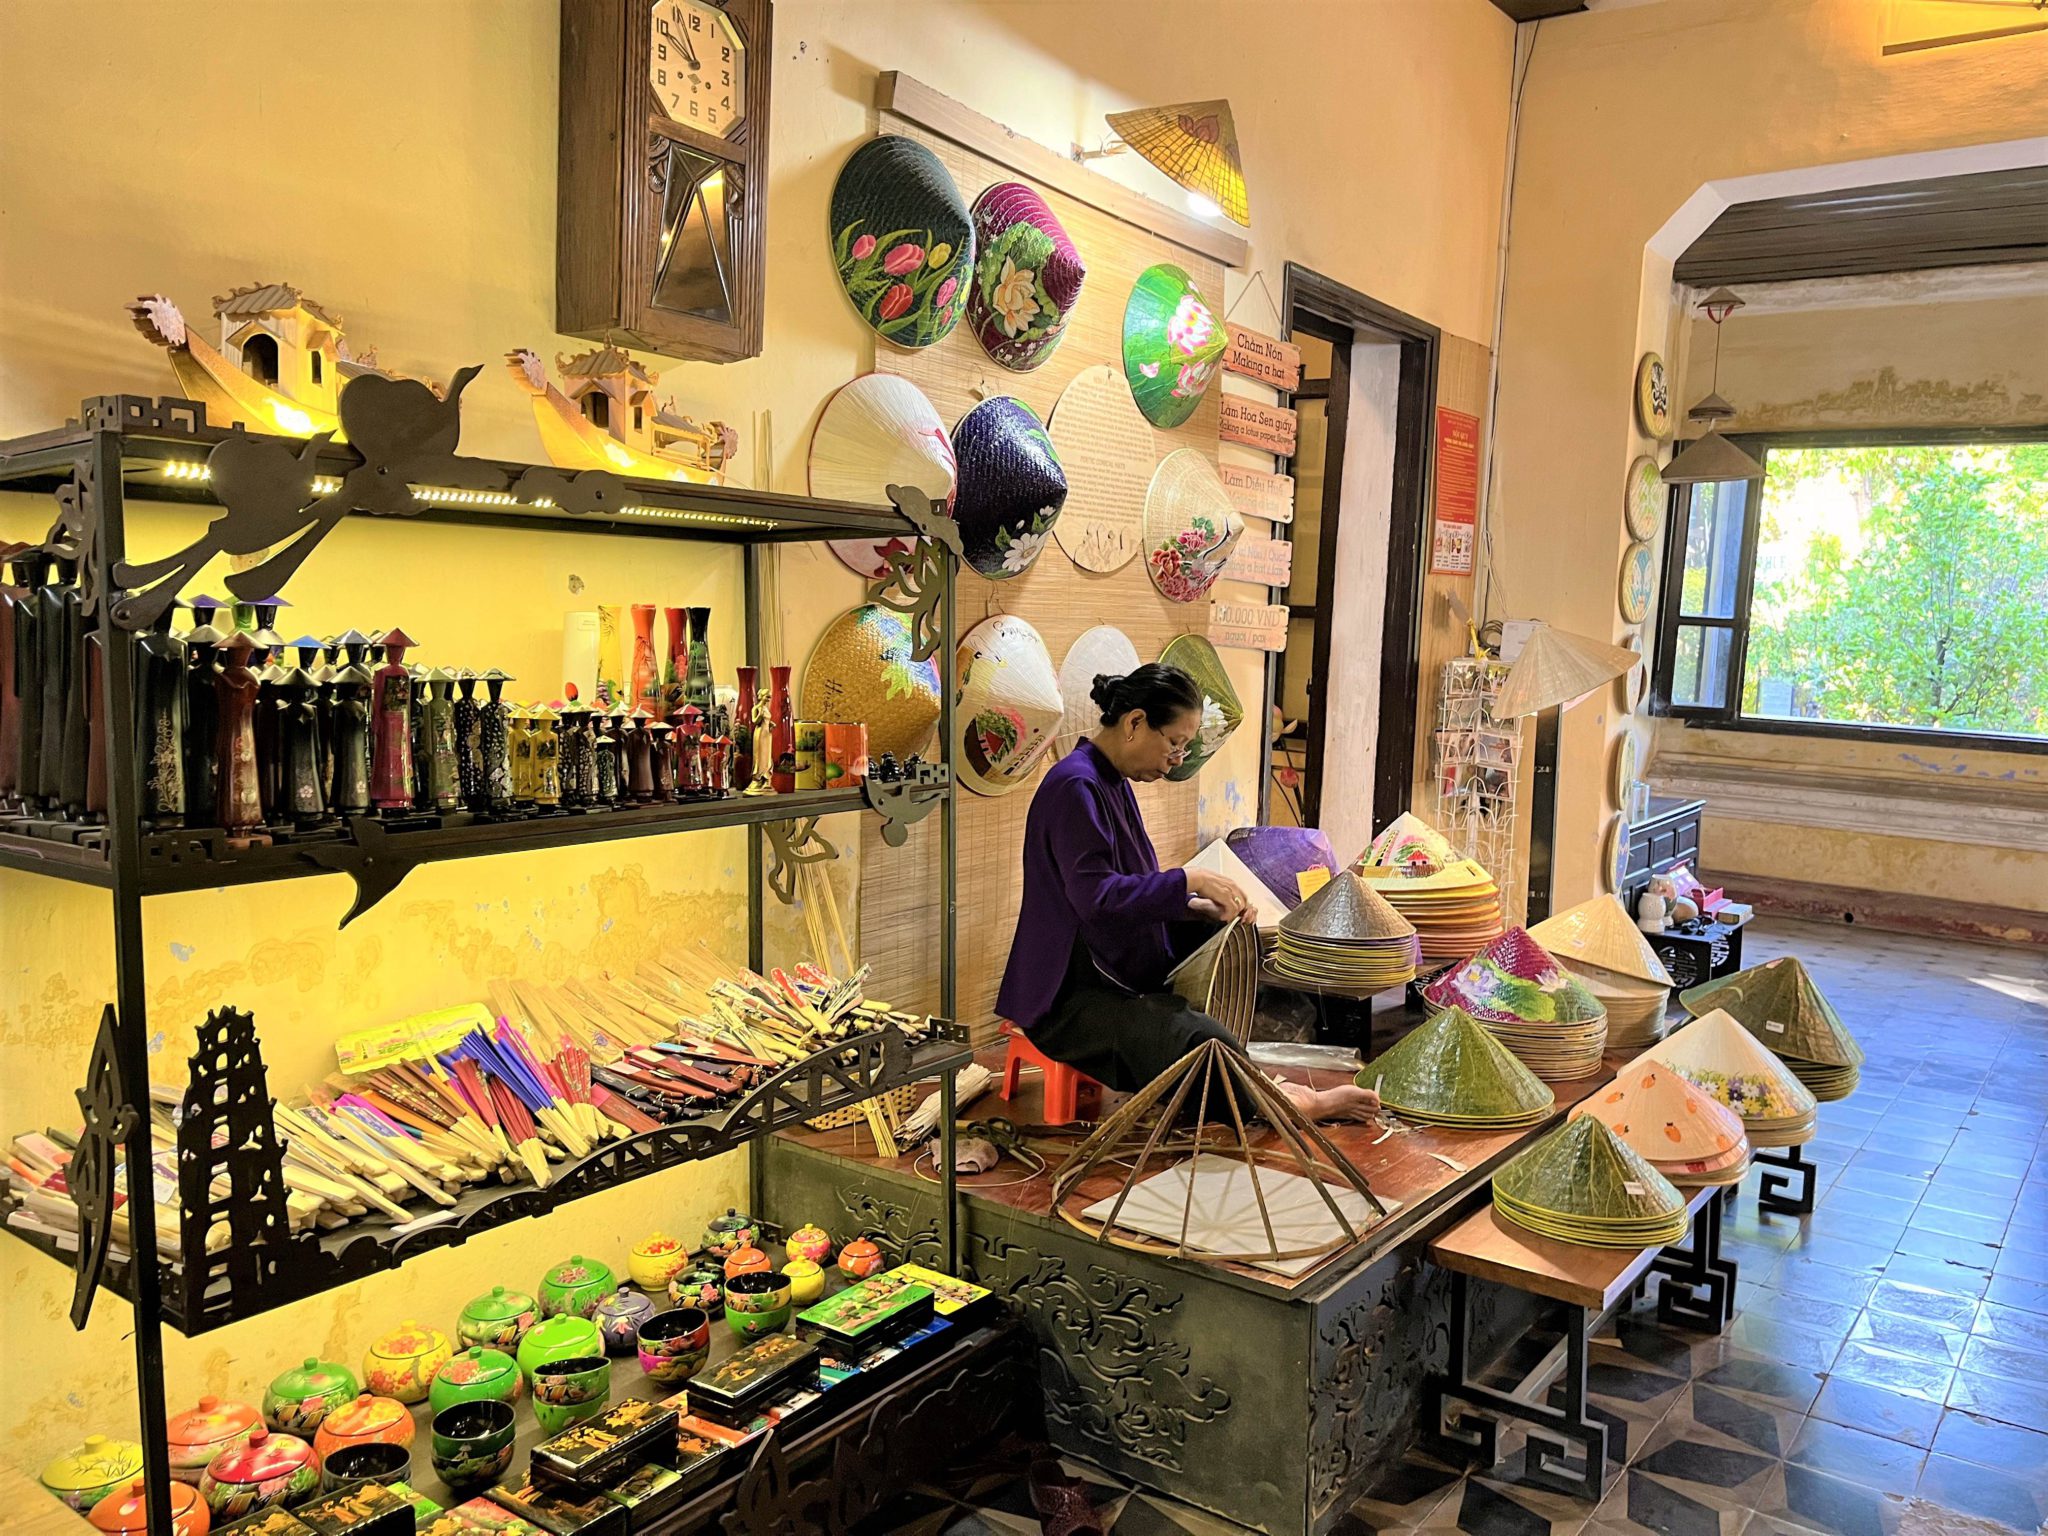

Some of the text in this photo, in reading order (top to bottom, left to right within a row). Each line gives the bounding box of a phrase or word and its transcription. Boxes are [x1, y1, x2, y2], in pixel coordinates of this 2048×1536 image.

[656, 17, 669, 36] 10
[689, 13, 700, 32] 12
[658, 43, 667, 61] 9
[721, 46, 730, 63] 2
[657, 68, 667, 86] 8
[721, 70, 730, 87] 3
[671, 93, 680, 109] 7
[690, 100, 698, 117] 6
[720, 95, 730, 111] 4
[708, 107, 717, 124] 5
[1265, 342, 1283, 361] Nón
[1232, 350, 1285, 379] Making a hat
[1240, 406, 1257, 423] Hoa
[1258, 411, 1274, 427] Sen
[1240, 426, 1245, 434] a
[1245, 426, 1259, 437] lotus
[1260, 432, 1276, 443] paper
[1256, 608, 1281, 627] VND
